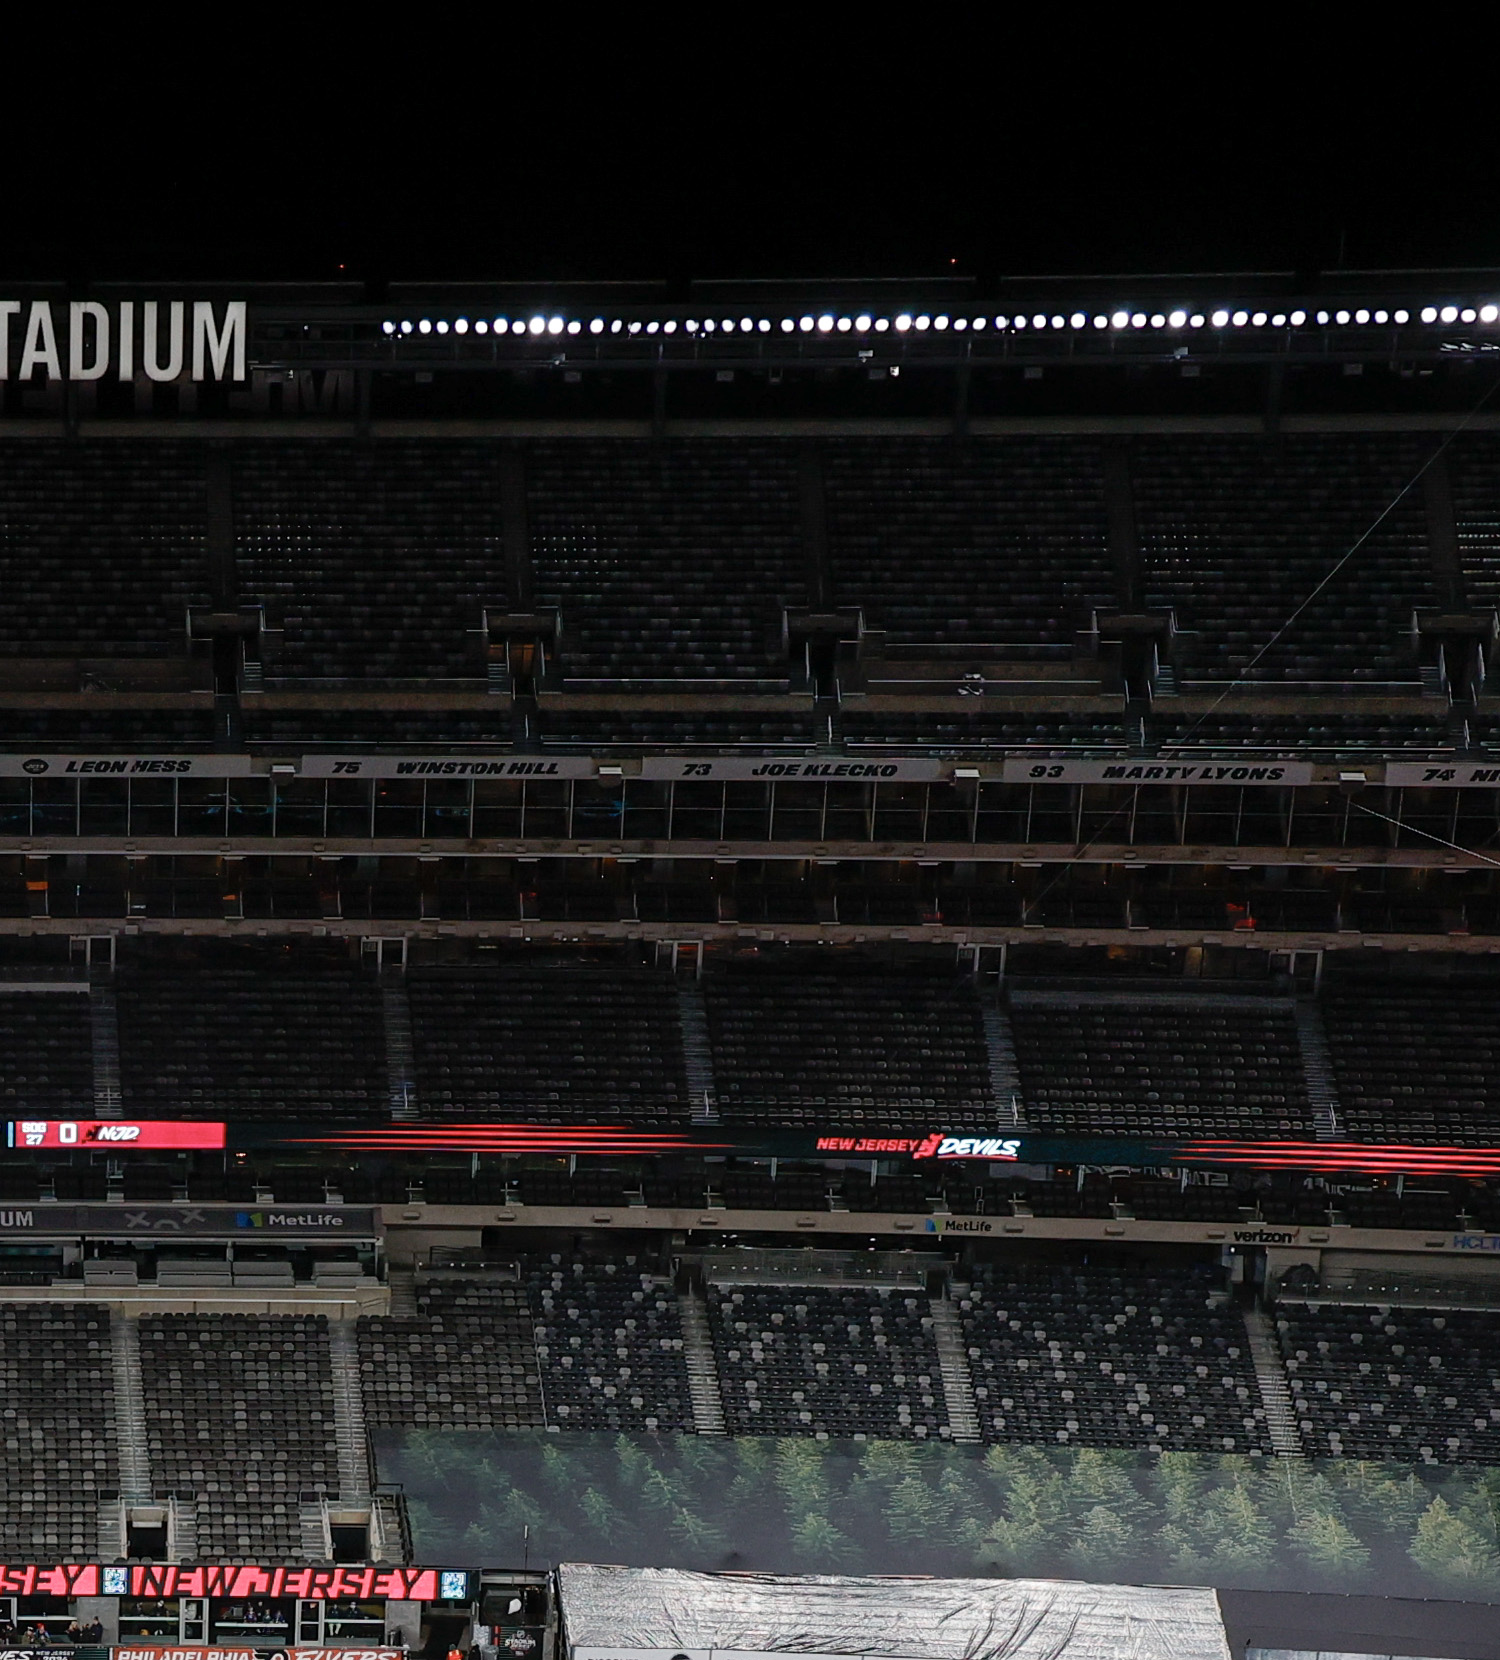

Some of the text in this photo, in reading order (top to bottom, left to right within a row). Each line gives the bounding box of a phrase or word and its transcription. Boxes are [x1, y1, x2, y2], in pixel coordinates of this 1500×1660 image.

[65, 759, 129, 773] LEON
[130, 759, 193, 773] HESS
[332, 761, 560, 776] 75 WINSTON HILL
[1421, 768, 1456, 782] 74
[25, 1134, 43, 1146] 27
[59, 1123, 78, 1144] 0
[97, 1126, 140, 1141] NJD
[268, 1213, 343, 1227] MetLife
[1233, 1229, 1294, 1245] verizon
